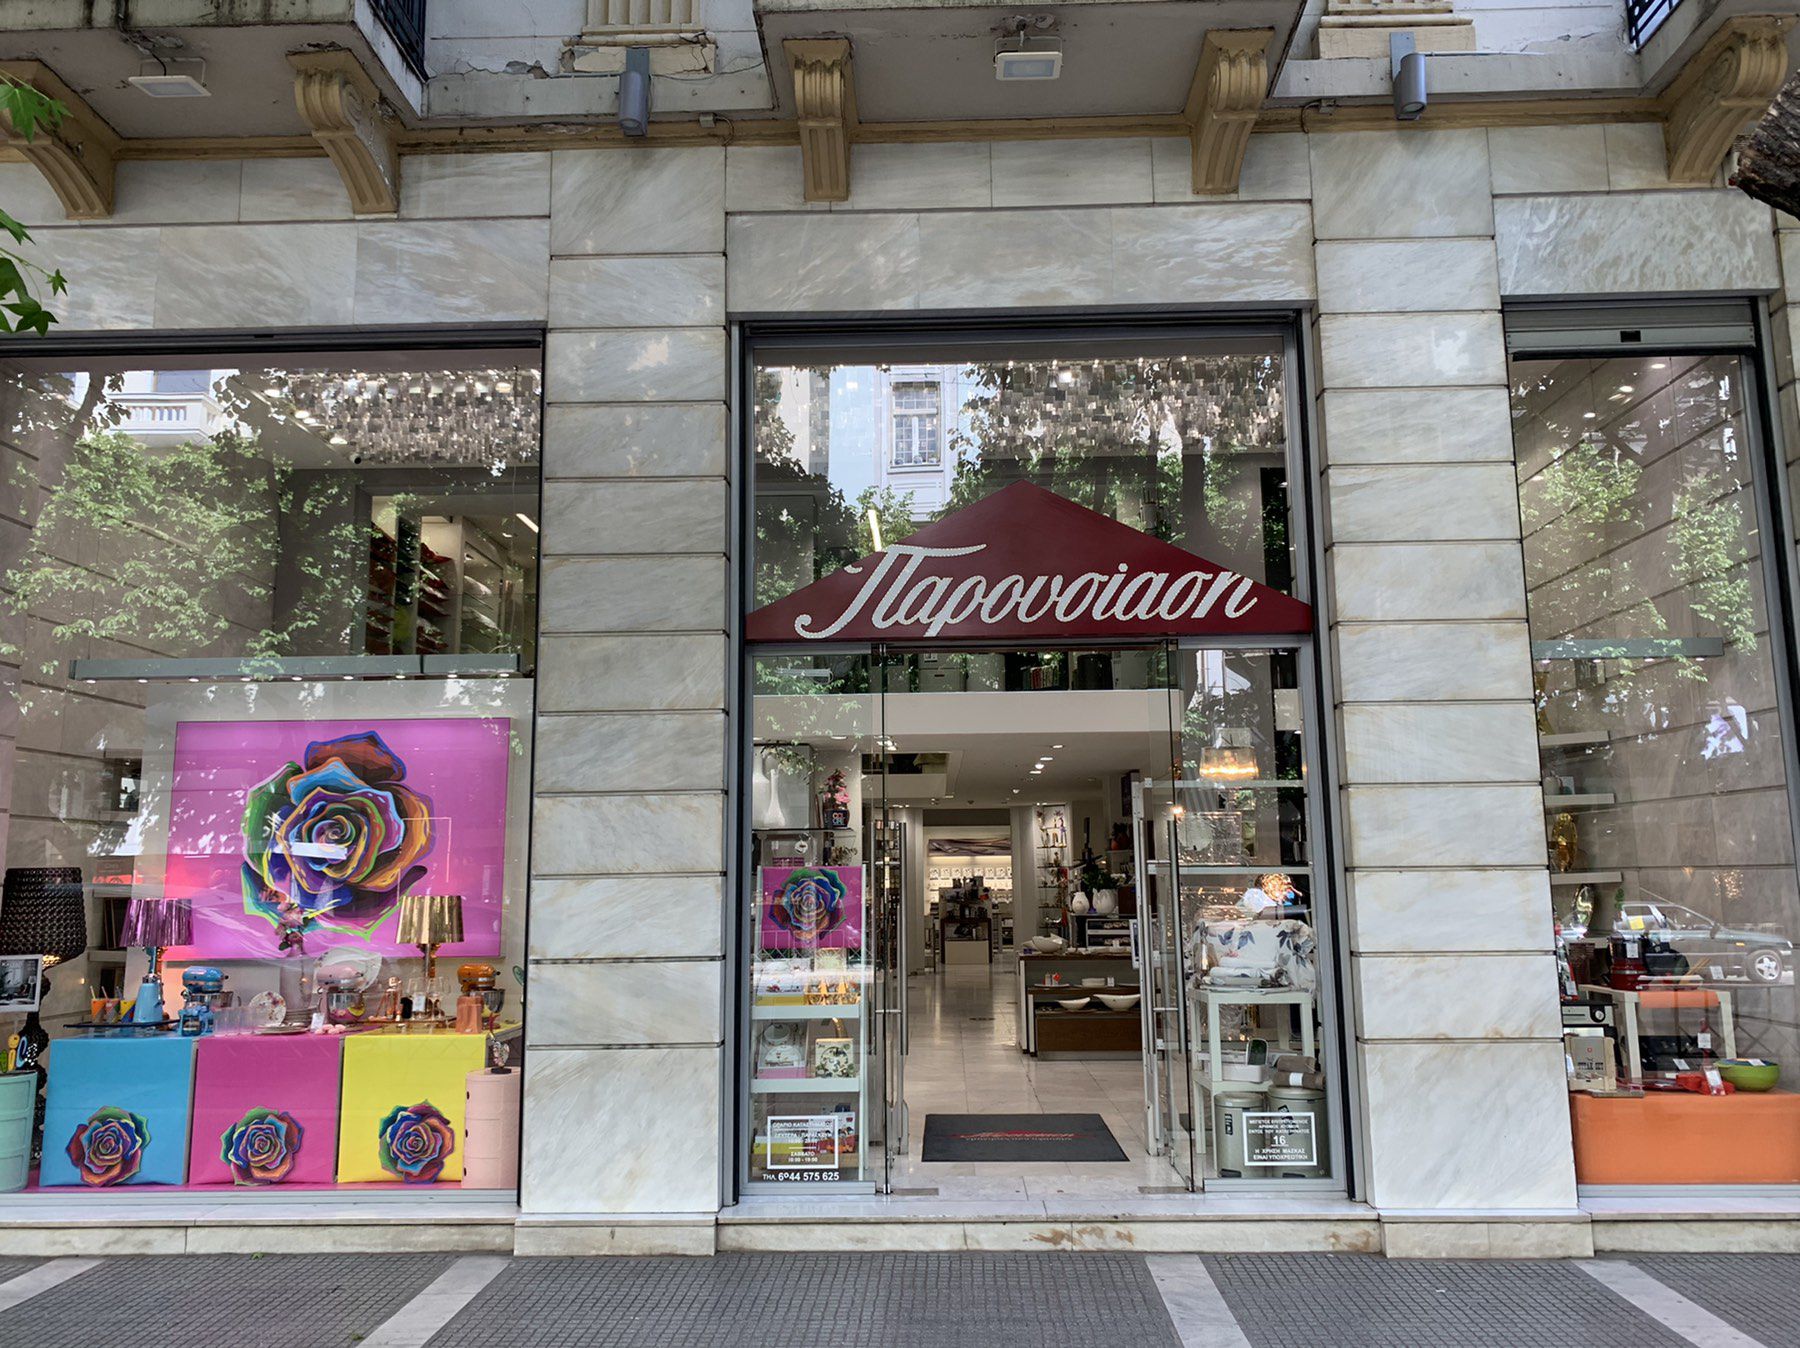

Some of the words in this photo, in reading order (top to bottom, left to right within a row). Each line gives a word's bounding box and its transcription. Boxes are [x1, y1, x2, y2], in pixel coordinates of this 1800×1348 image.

[1273, 1135, 1286, 1145] 16
[803, 1172, 821, 1181] 575
[822, 1172, 840, 1181] 625
